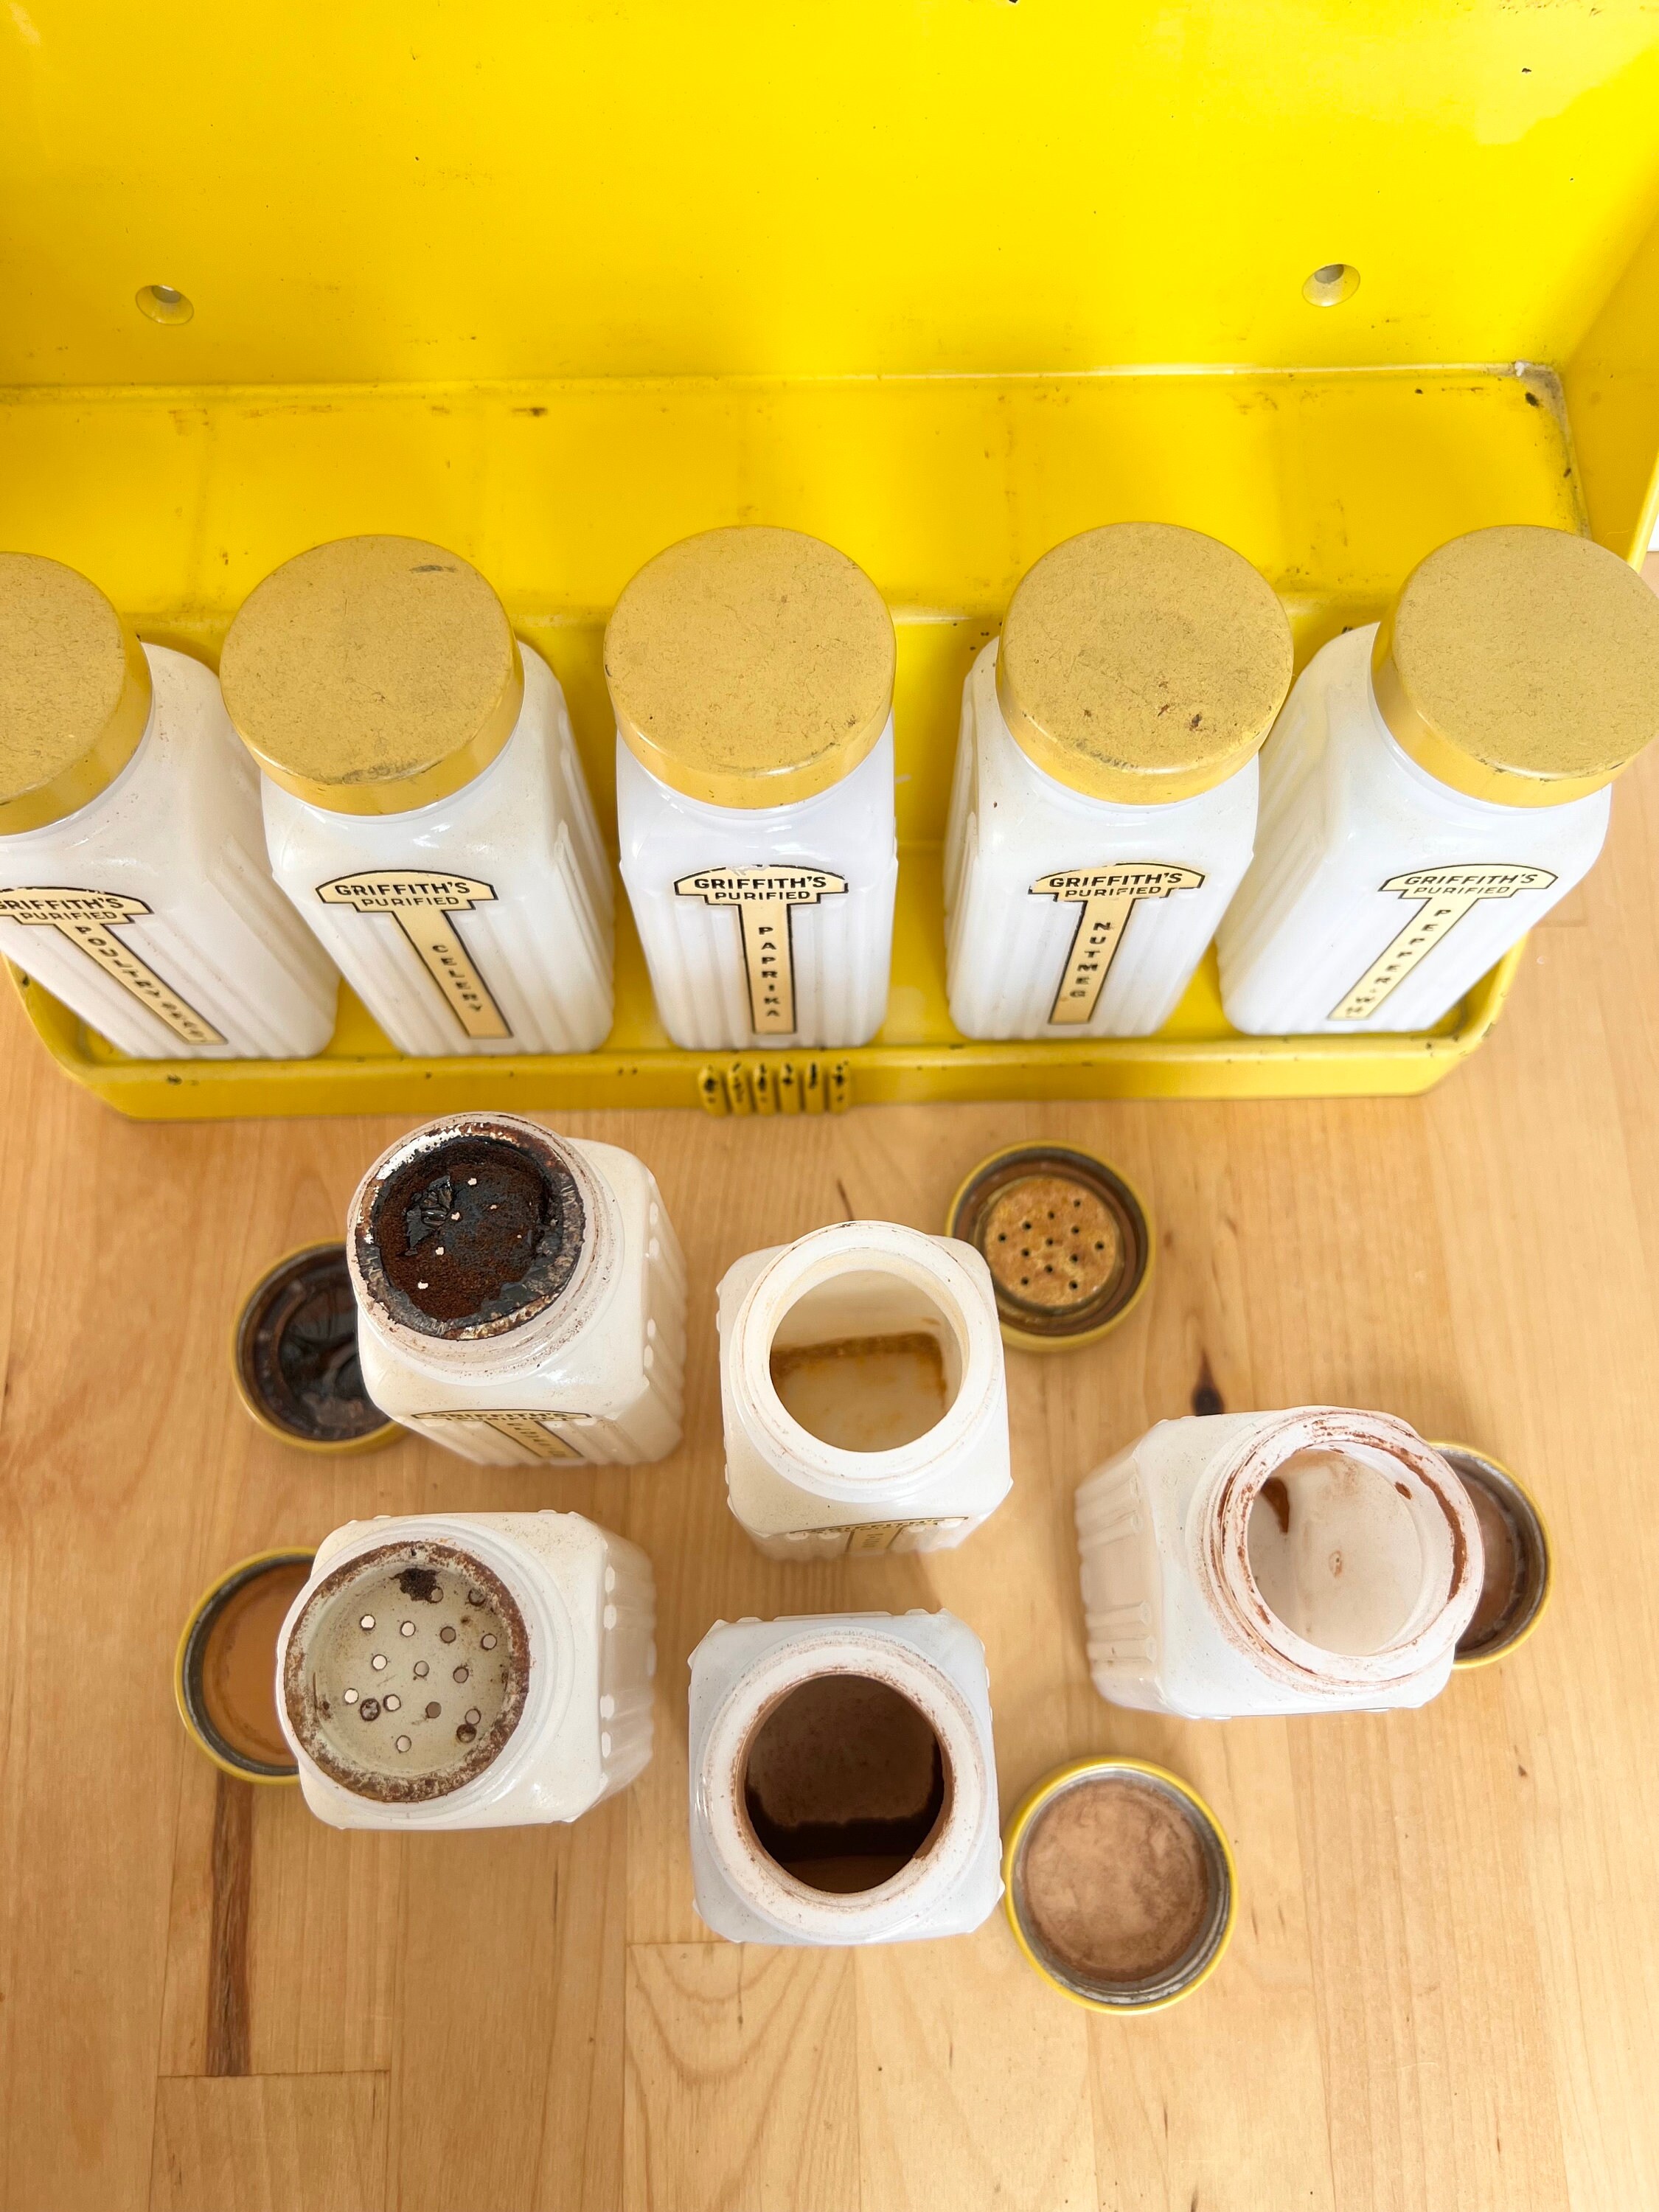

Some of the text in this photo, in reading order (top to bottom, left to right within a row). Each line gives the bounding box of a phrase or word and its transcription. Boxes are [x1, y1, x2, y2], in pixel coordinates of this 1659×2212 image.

[695, 877, 827, 889] GRIFFITH'S
[1048, 872, 1183, 888] GRIFFITH'S
[1404, 874, 1538, 885] GRIFFITH'S
[335, 882, 470, 896] GRIFFITH'S
[1064, 886, 1162, 897] PURIFIED
[1413, 886, 1511, 894] PURIFIED
[361, 897, 460, 906] PURIFIED
[714, 891, 811, 900] PURIFIED
[19, 911, 118, 920] PURIFIED
[1374, 909, 1451, 985] PEPPER
[1069, 922, 1113, 998] NUTMEG
[758, 927, 781, 1018] PAPRIKA
[432, 945, 483, 1013] CELERY
